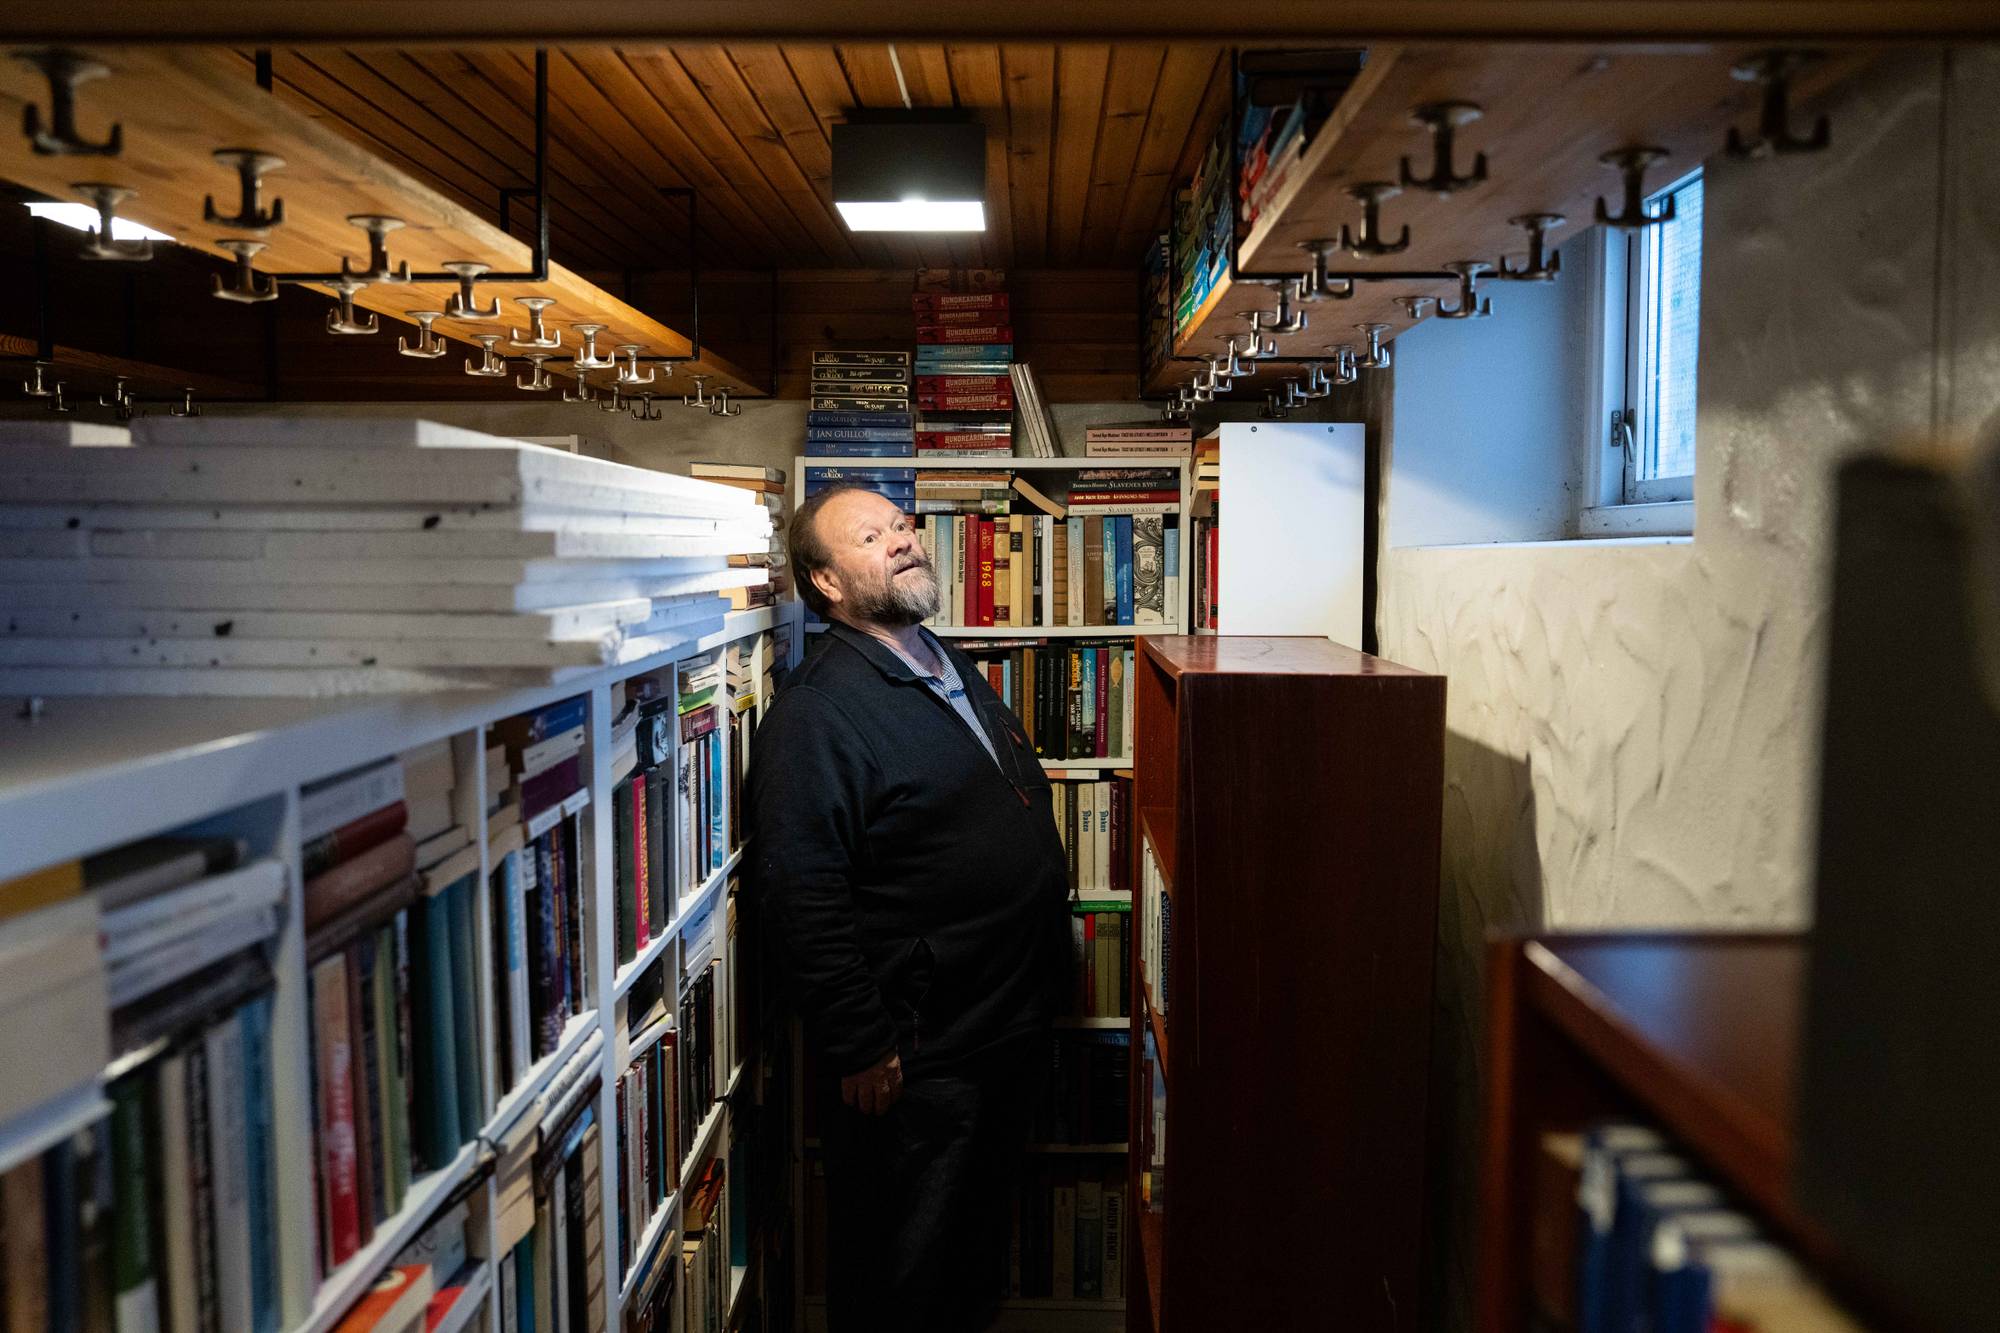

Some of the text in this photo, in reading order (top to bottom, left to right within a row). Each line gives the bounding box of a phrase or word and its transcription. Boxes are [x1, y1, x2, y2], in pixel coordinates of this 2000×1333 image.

[817, 430, 832, 438] JAN
[834, 430, 871, 438] GUILLOU
[982, 561, 992, 587] 1968
[1071, 653, 1079, 688] BACKMAN
[1082, 809, 1091, 832] Naken
[1099, 809, 1109, 832] Naken
